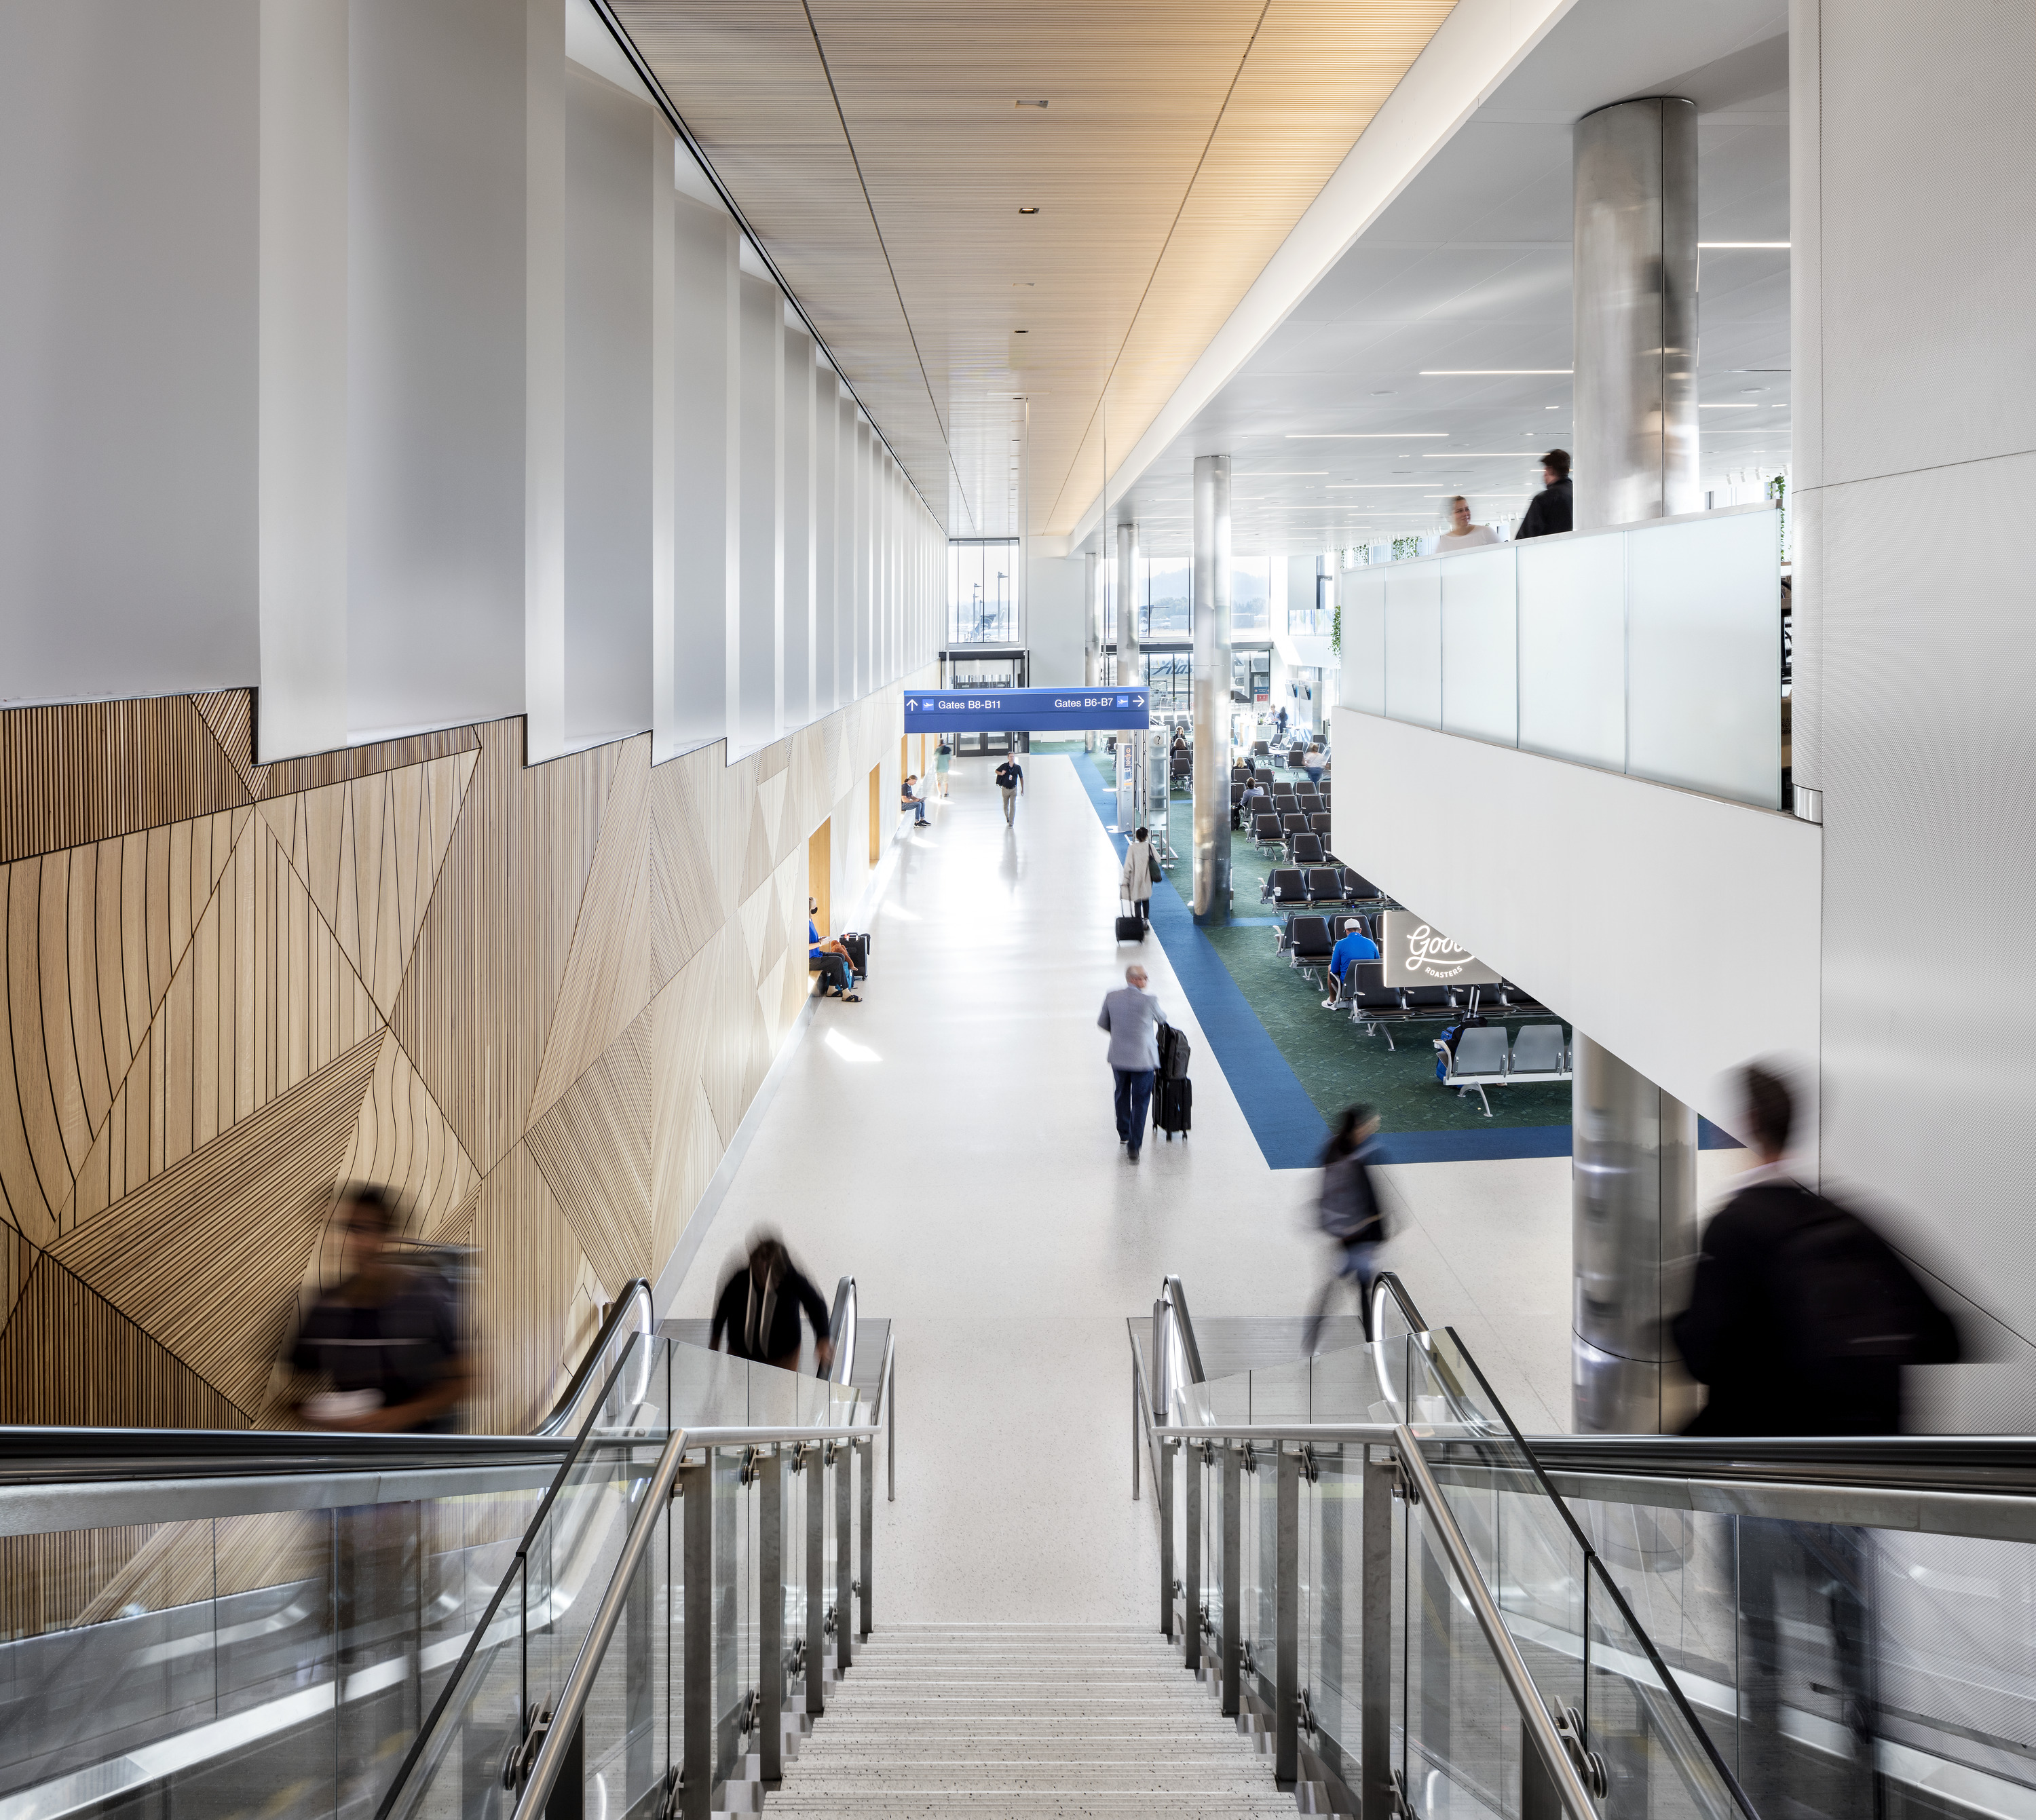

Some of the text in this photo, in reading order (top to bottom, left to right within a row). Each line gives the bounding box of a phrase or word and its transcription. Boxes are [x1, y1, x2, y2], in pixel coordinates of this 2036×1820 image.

[938, 700, 1000, 709] Gates B8-B11
[1055, 698, 1113, 708] Gates B6-B7
[1425, 966, 1463, 978] ROASTERS
